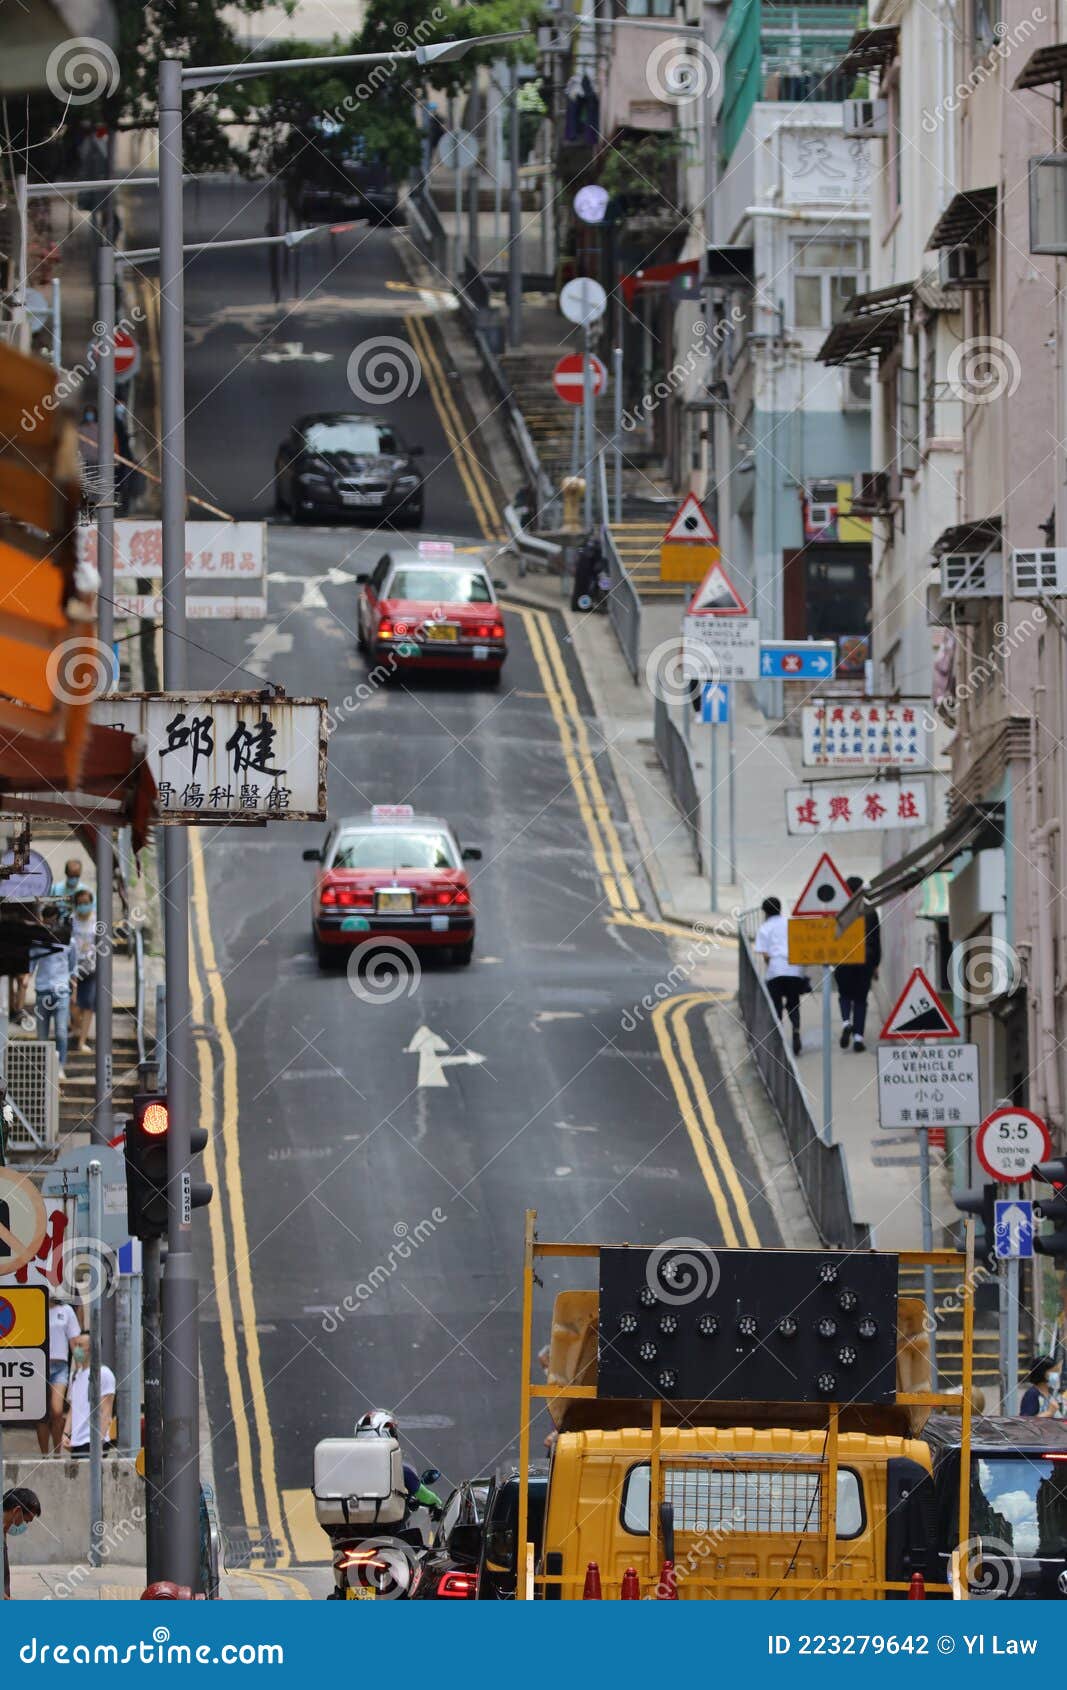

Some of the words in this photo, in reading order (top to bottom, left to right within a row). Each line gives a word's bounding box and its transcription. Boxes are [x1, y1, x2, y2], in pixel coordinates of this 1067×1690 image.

[795, 791, 919, 826] 建興茶莊
[892, 1049, 944, 1059] BEWARE
[948, 1048, 964, 1058] OF
[902, 1062, 954, 1071] VEHICLE
[883, 1074, 938, 1085] ROLLING
[941, 1072, 974, 1083] BACK
[915, 1089, 944, 1102] 小心
[996, 1146, 1030, 1154] tonnes
